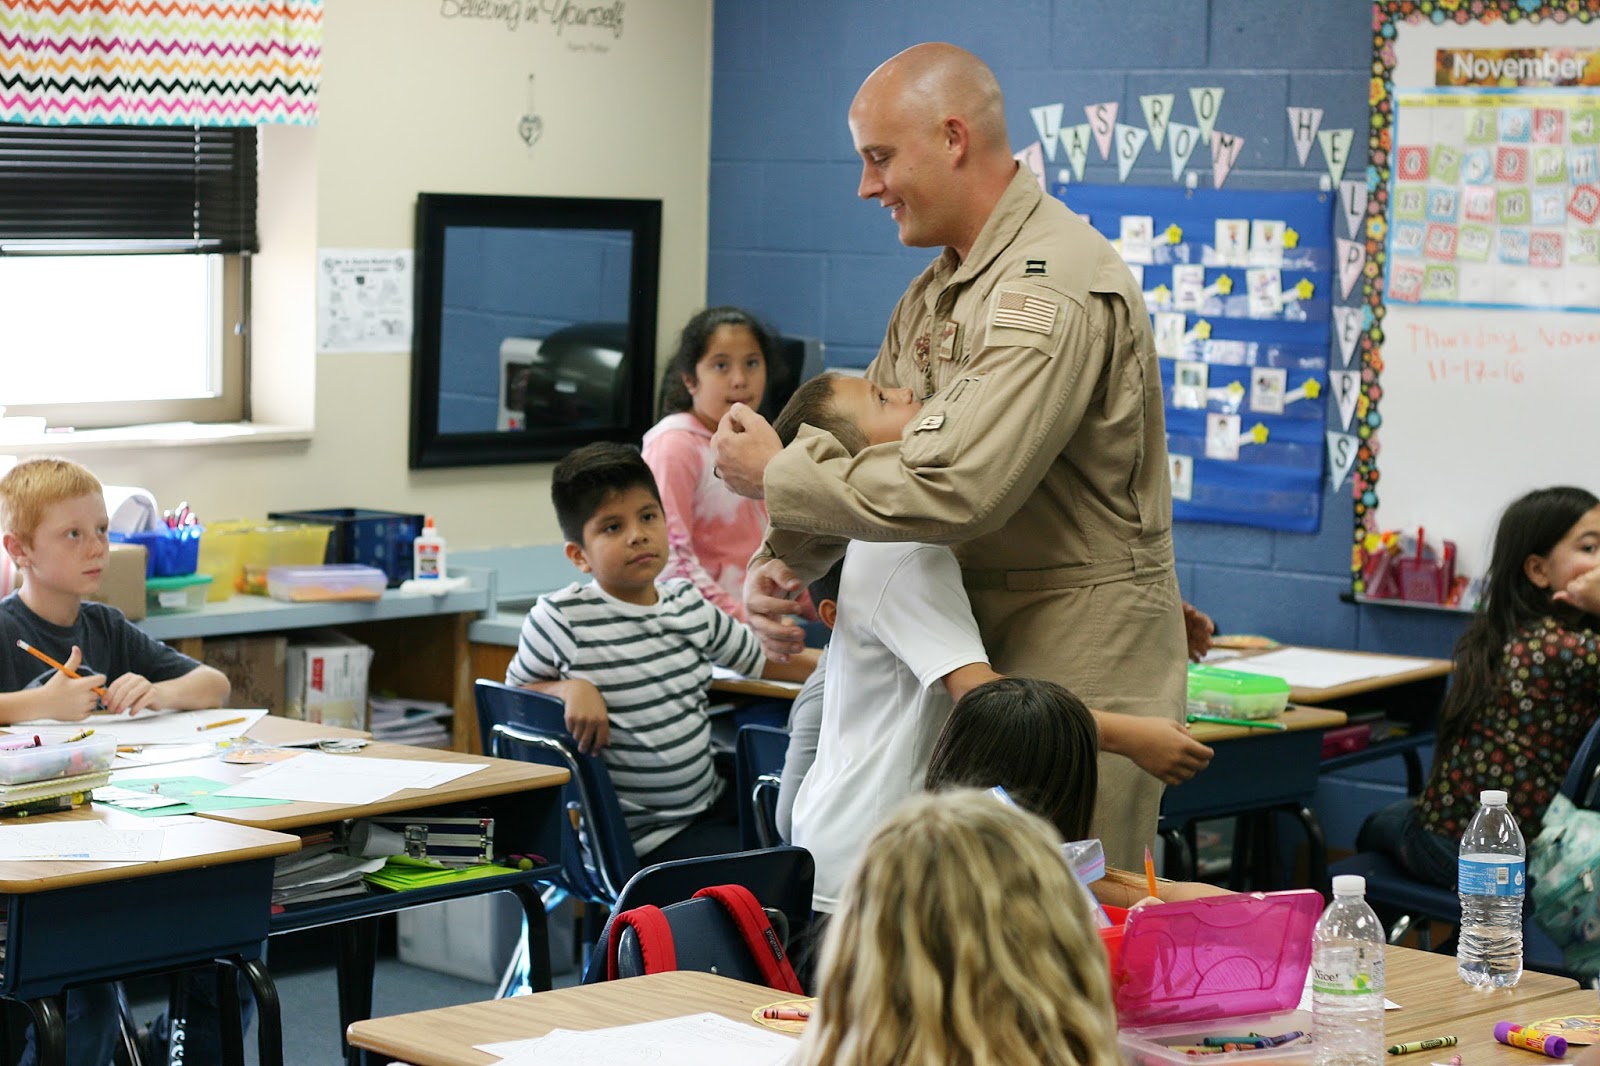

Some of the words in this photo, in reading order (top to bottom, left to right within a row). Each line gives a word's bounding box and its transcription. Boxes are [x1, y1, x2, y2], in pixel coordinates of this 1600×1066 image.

[1453, 53, 1588, 79] November
[1506, 153, 1518, 172] 9
[1537, 325, 1600, 348] Nove
